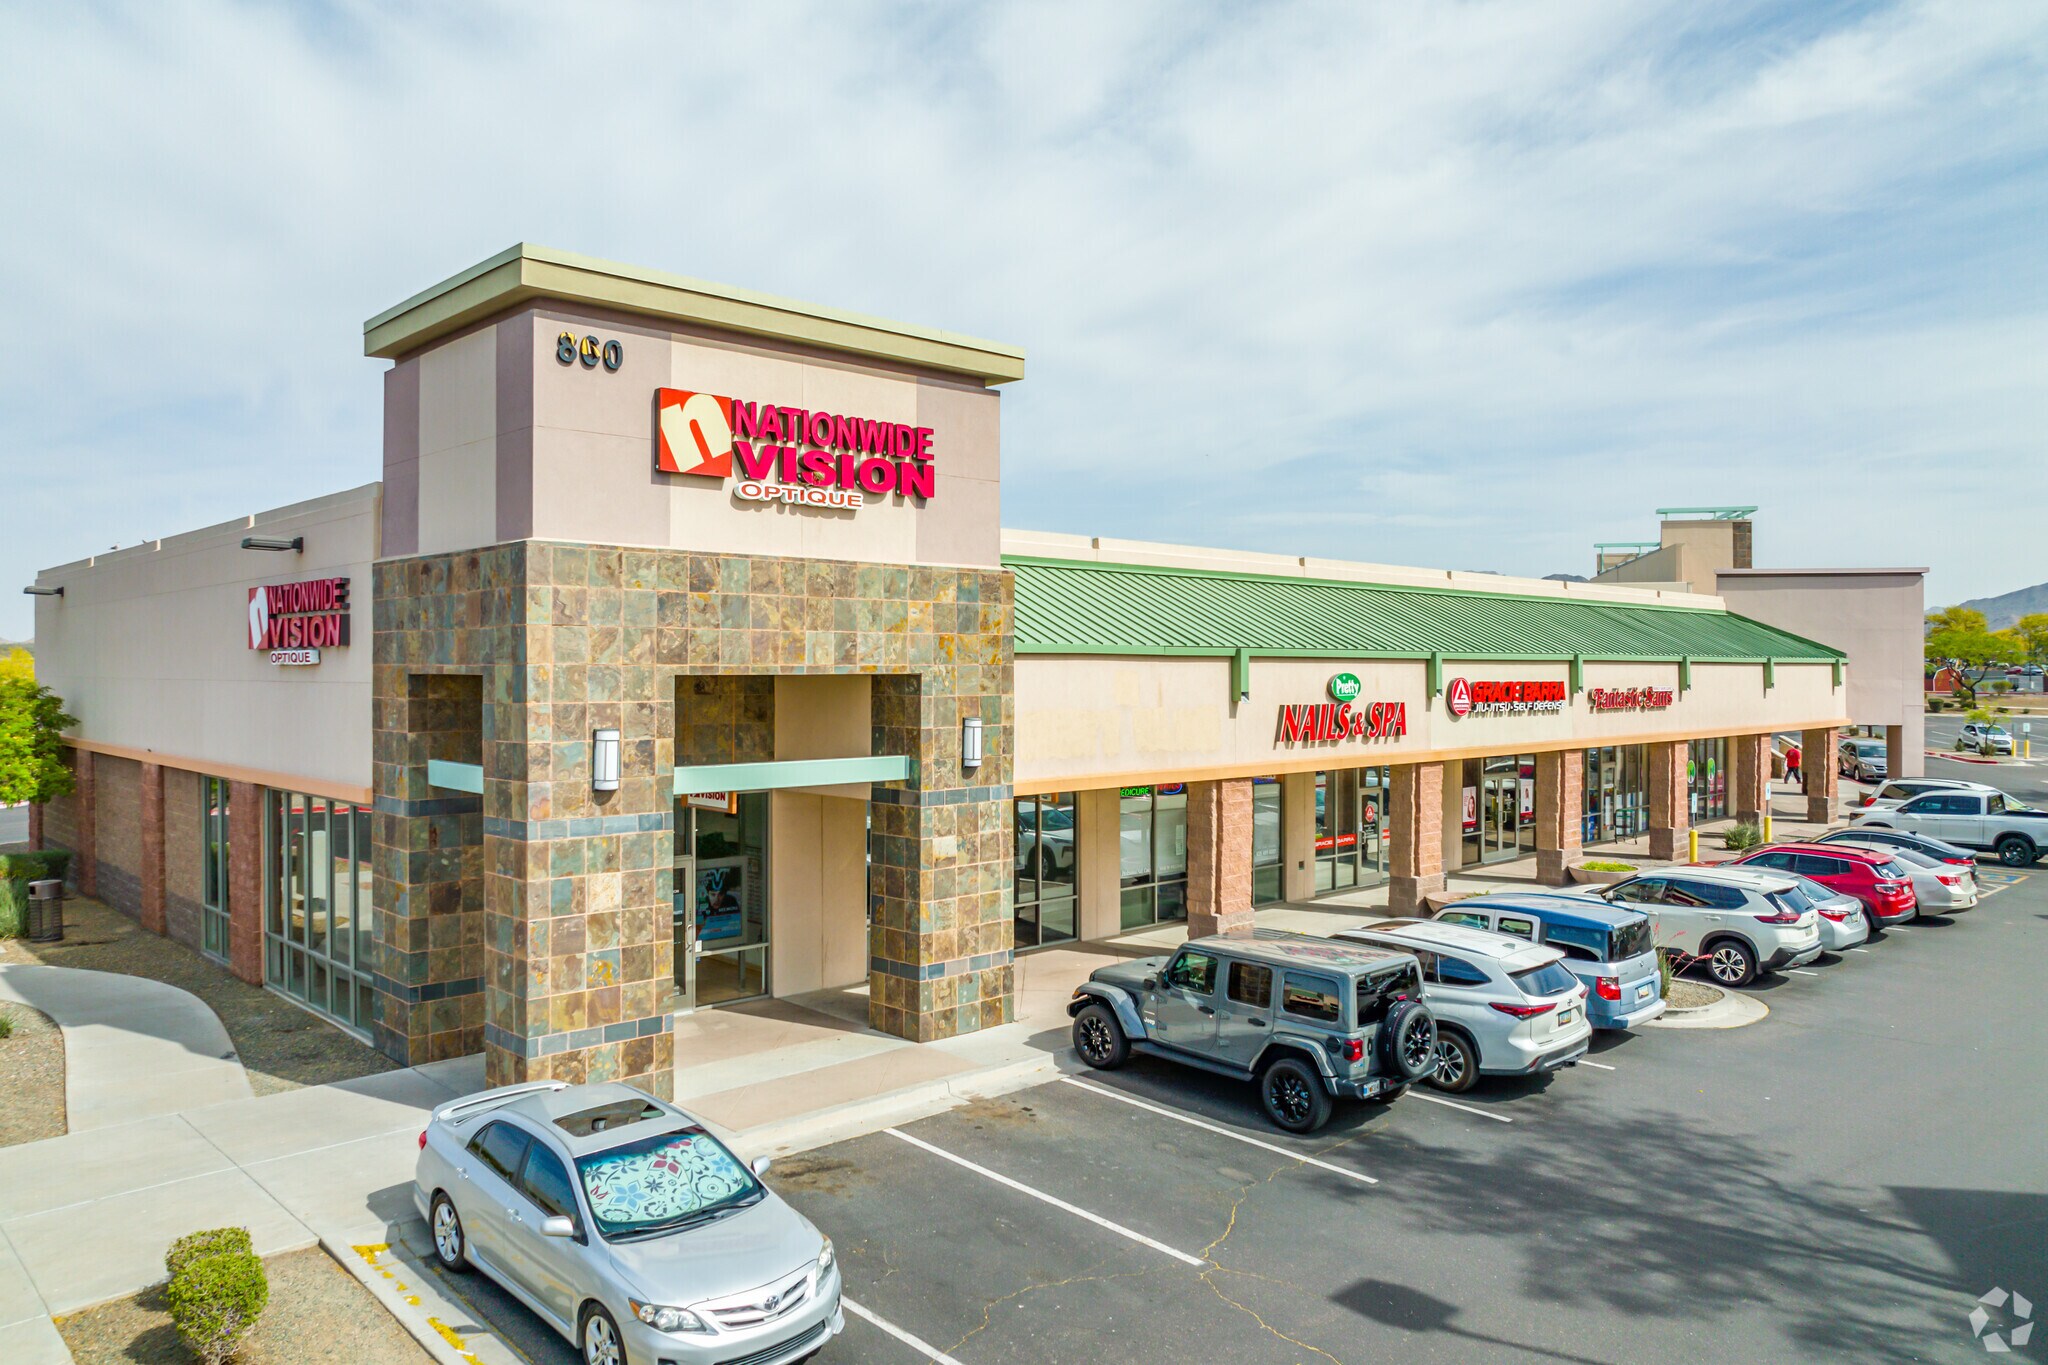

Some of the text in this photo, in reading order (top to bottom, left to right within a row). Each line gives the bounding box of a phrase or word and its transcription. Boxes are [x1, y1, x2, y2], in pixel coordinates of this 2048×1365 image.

[558, 332, 623, 369] 860
[733, 399, 935, 461] NATIONWIDE
[733, 441, 935, 498] VISION
[740, 483, 863, 508] OPTIQUE
[268, 577, 343, 614] NATIONWIDE
[269, 614, 341, 648] VISION
[270, 652, 311, 664] OPTIQUE
[1335, 678, 1360, 697] Pretty
[1472, 681, 1566, 702] GRACIE BARRA
[1593, 686, 1673, 709] Fantastic Sams
[1514, 701, 1532, 711] SELF
[1533, 700, 1567, 711] DEFENSE
[1280, 701, 1407, 742] NAILS & SPA
[1120, 787, 1149, 796] EDICURE
